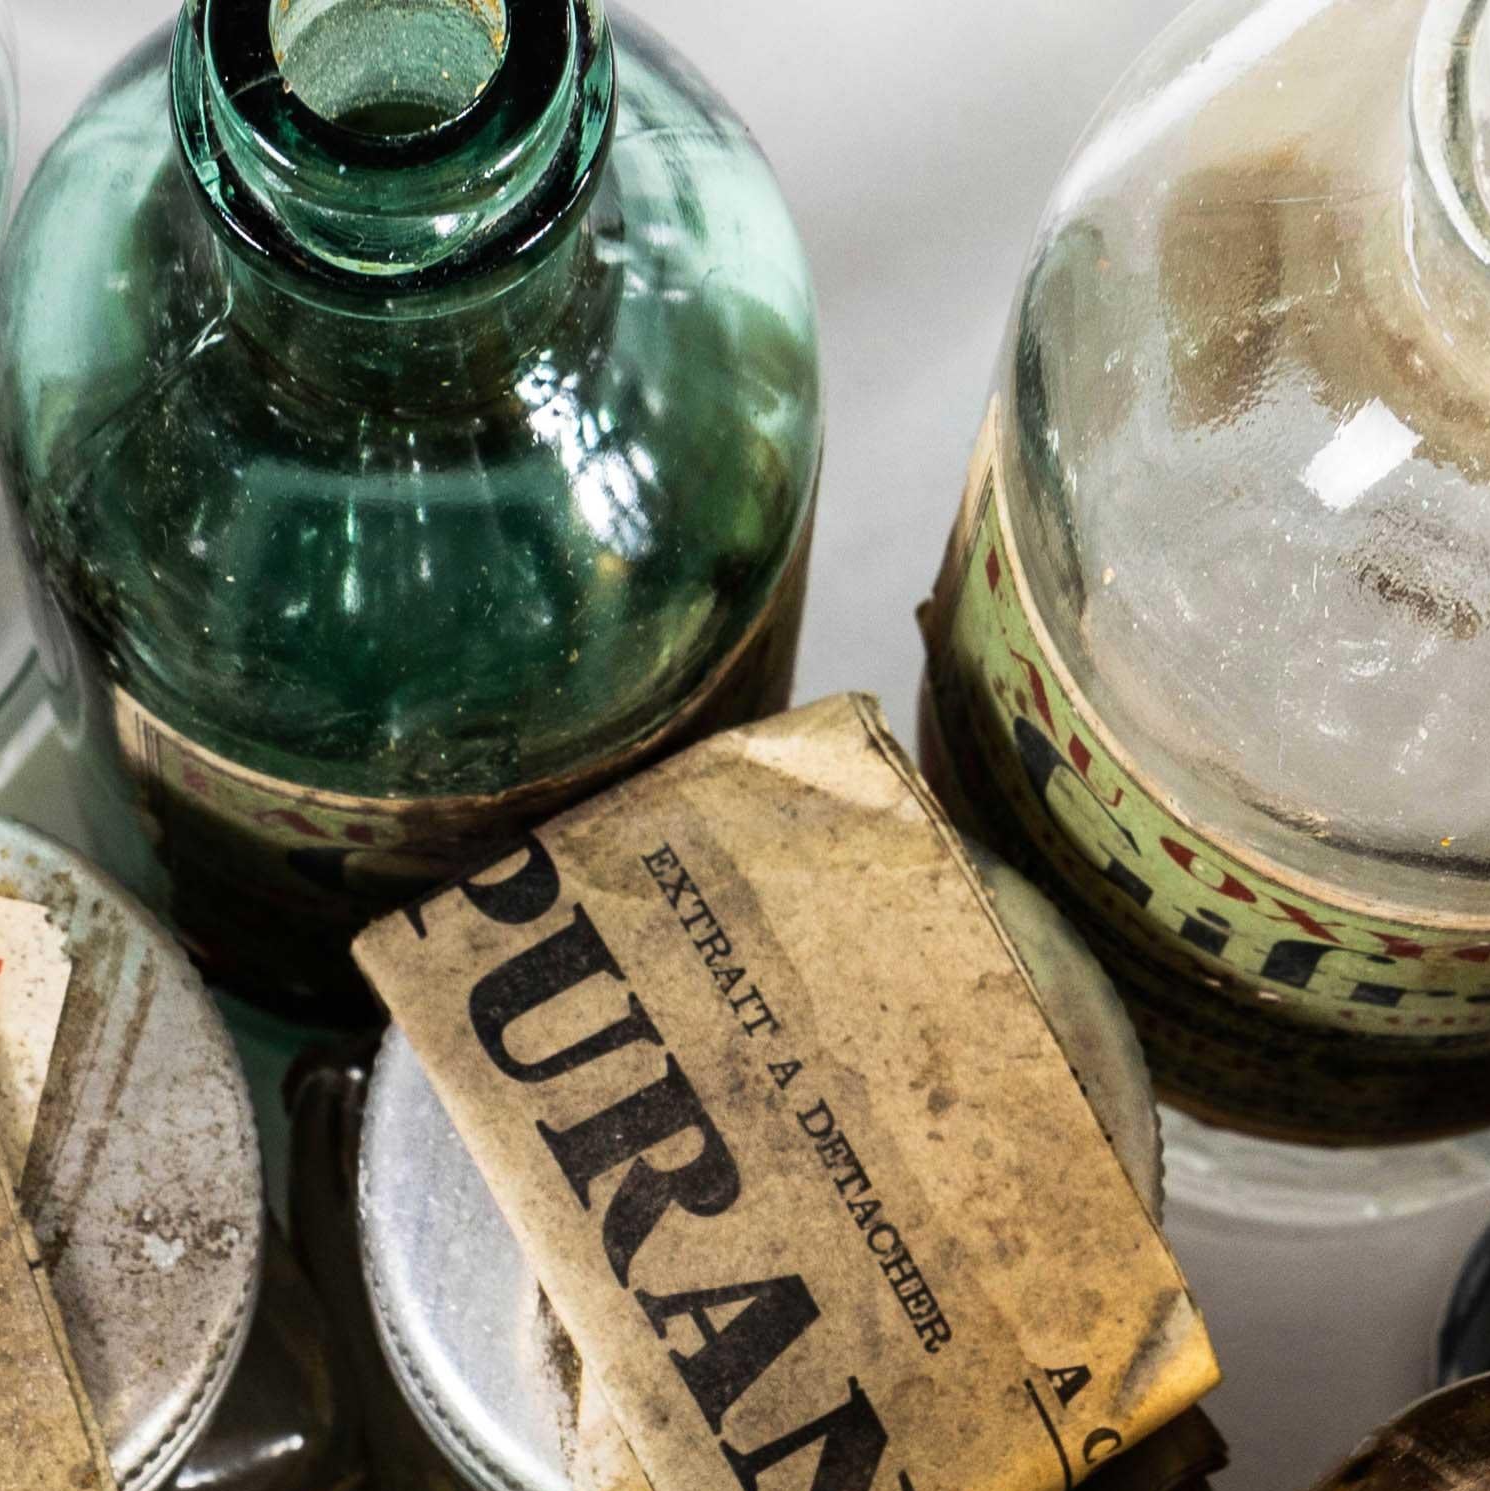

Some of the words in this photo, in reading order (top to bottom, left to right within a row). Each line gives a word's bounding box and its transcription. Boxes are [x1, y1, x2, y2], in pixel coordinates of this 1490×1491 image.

[640, 841, 782, 1038] EXTRAIT
[767, 1057, 805, 1092] A
[795, 1101, 955, 1354] DETACHER
[1042, 1362, 1094, 1409] A
